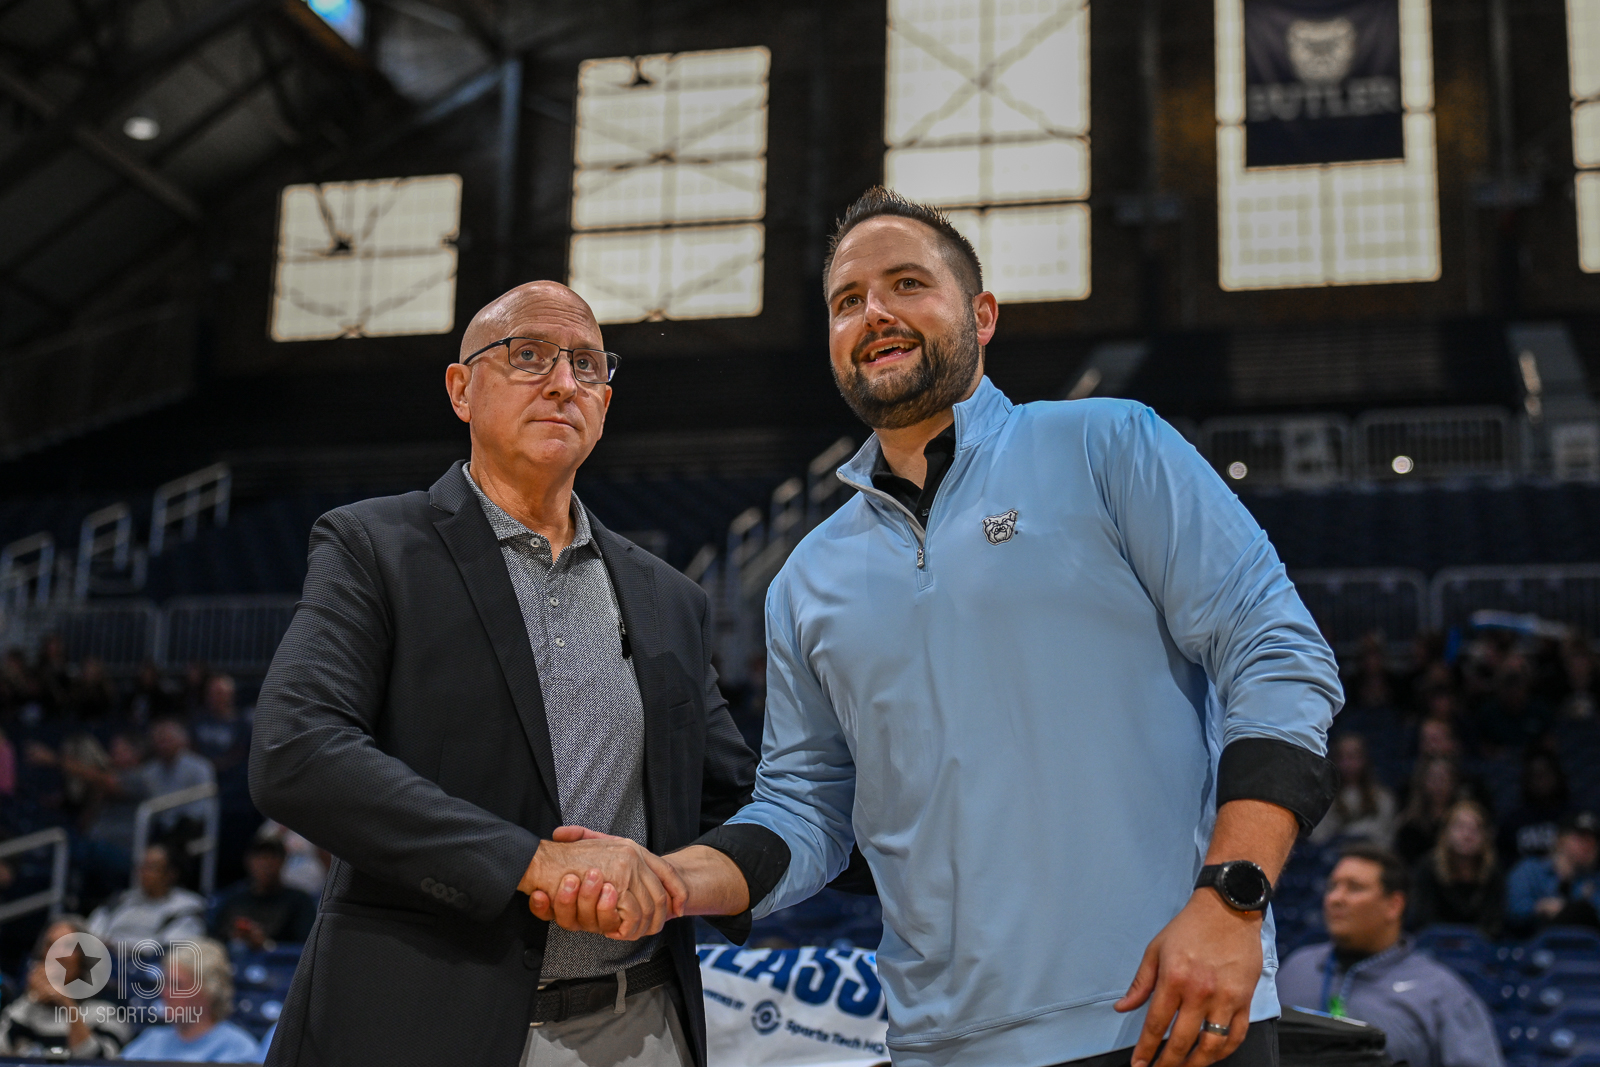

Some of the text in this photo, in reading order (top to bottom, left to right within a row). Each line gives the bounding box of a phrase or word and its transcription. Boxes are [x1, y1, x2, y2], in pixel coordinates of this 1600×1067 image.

[786, 1019, 885, 1055] Sports Tech HQ
